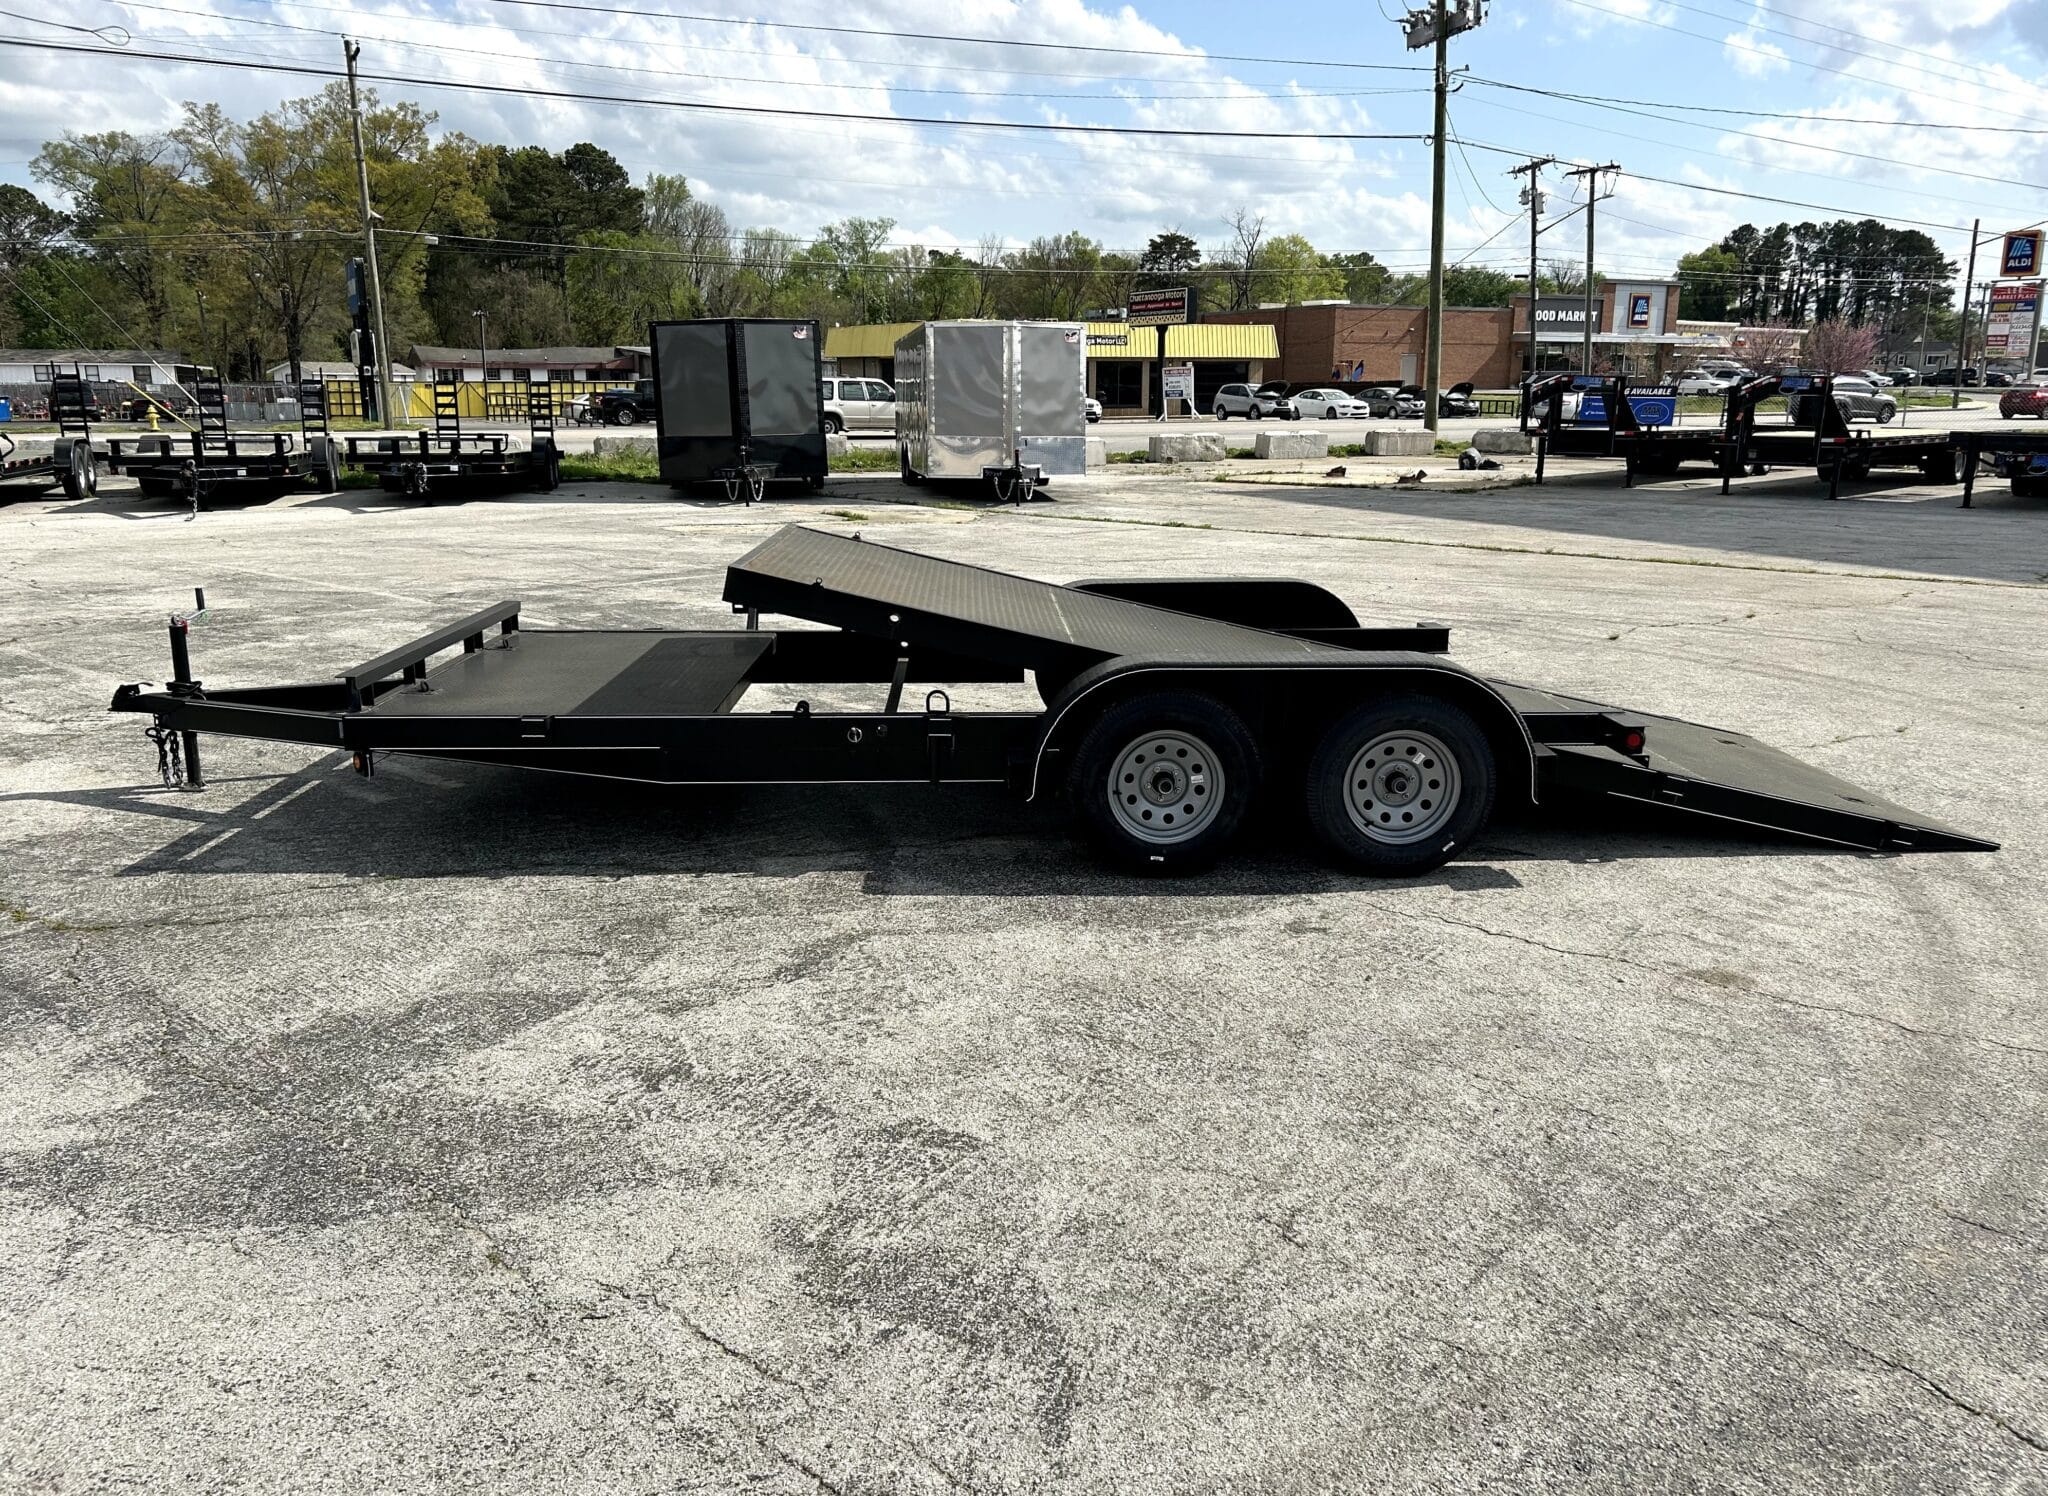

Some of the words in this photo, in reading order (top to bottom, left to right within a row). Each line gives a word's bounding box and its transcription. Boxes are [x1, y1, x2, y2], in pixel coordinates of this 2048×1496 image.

[2007, 257, 2032, 267] ALDI
[1129, 293, 1164, 302] Chattanooga
[1165, 291, 1186, 300] Motors
[1536, 310, 1556, 322] OOD
[1557, 310, 1598, 322] MARKT
[1096, 337, 1115, 345] Motor
[1631, 388, 1672, 396] AVAILABLE
